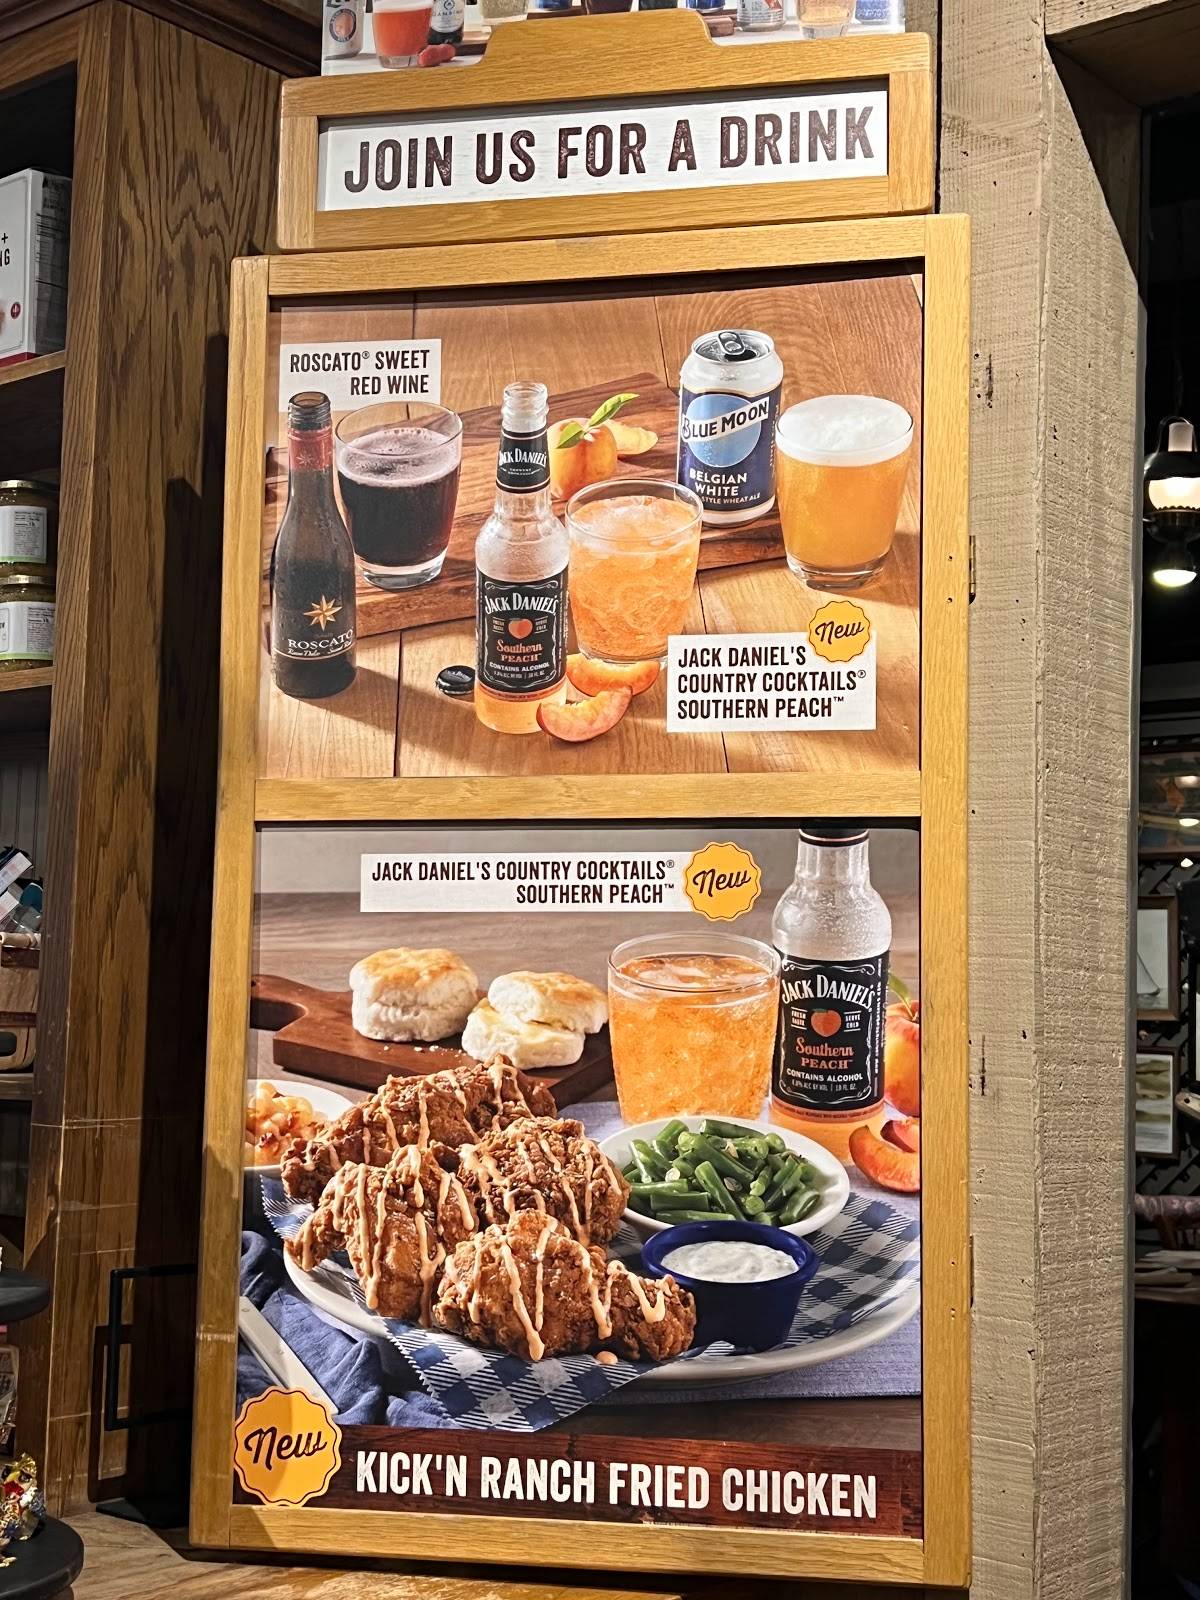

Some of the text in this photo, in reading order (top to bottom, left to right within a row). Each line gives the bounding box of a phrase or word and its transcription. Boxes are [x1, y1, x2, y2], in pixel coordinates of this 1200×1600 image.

[344, 105, 875, 193] JOIN US FOR A DRINK
[375, 349, 430, 371] SWEET
[350, 374, 429, 396] RED WINE
[682, 401, 768, 439] BLUE MOON
[689, 467, 748, 485] BELGIAN
[694, 481, 740, 497] WHITE
[723, 496, 748, 505] WHEAT
[748, 492, 761, 501] ALE
[484, 592, 559, 616] JACK DANIEL'S
[287, 628, 354, 650] ROSCATO
[815, 620, 864, 644] New
[497, 639, 542, 653] Southern
[678, 645, 806, 668] JACK DANIEL'S
[677, 672, 758, 694] COUNTRY
[677, 699, 769, 720] SOUTHERN
[372, 862, 413, 882] JACK
[418, 861, 491, 881] DANIEL'S
[496, 861, 572, 881] COUNTRY
[516, 884, 603, 904] SOUTHERN
[692, 868, 752, 898] New
[781, 974, 875, 1013] JACK DANIEL'S
[796, 1037, 854, 1056] Southern
[786, 1067, 864, 1082] CONTAINS ALCOHOL
[244, 1429, 327, 1470] New
[356, 1450, 877, 1519] KICK'N RANCH FRIED CHICKEN
